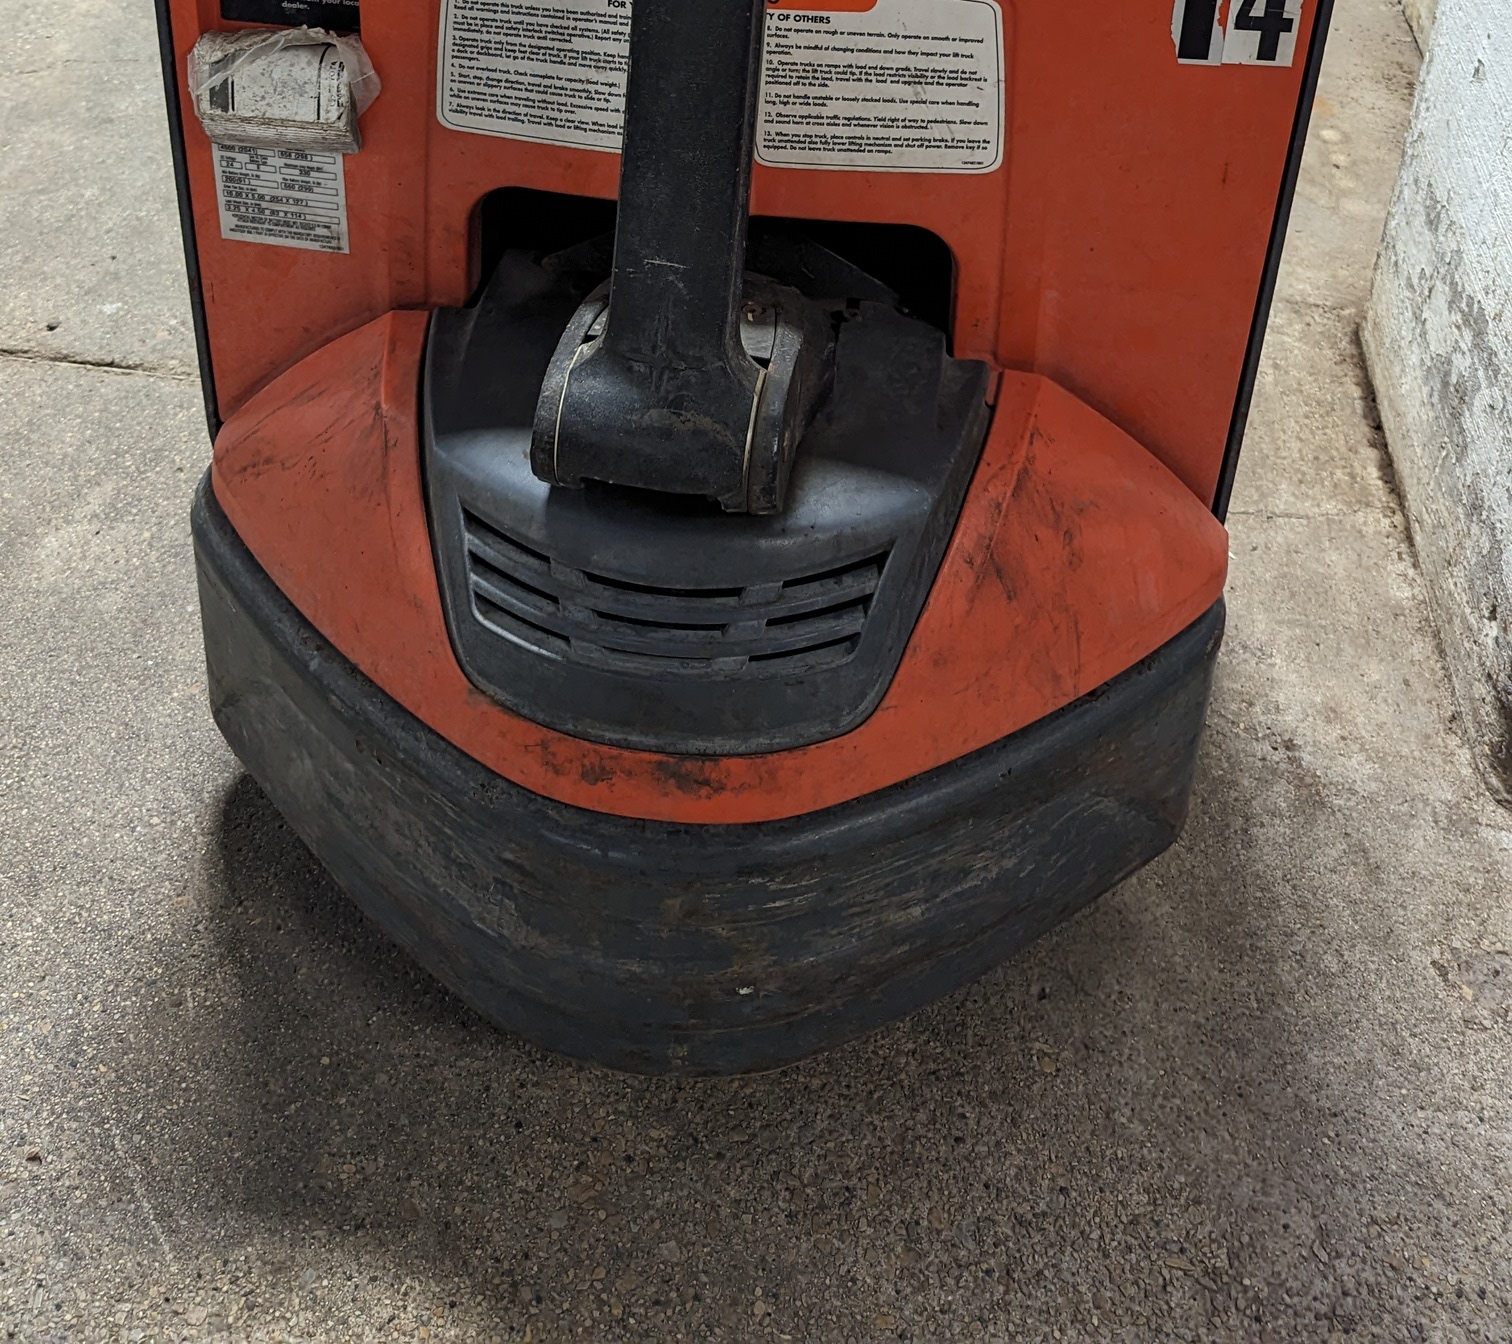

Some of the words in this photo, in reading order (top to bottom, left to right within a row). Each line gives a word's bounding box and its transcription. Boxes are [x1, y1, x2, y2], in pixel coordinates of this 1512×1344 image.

[282, 1, 310, 10] dealer.
[607, 0, 627, 9] FOR
[777, 13, 791, 22] OF
[793, 14, 831, 24] OTHERS
[831, 46, 855, 54] changing
[920, 50, 938, 58] impact
